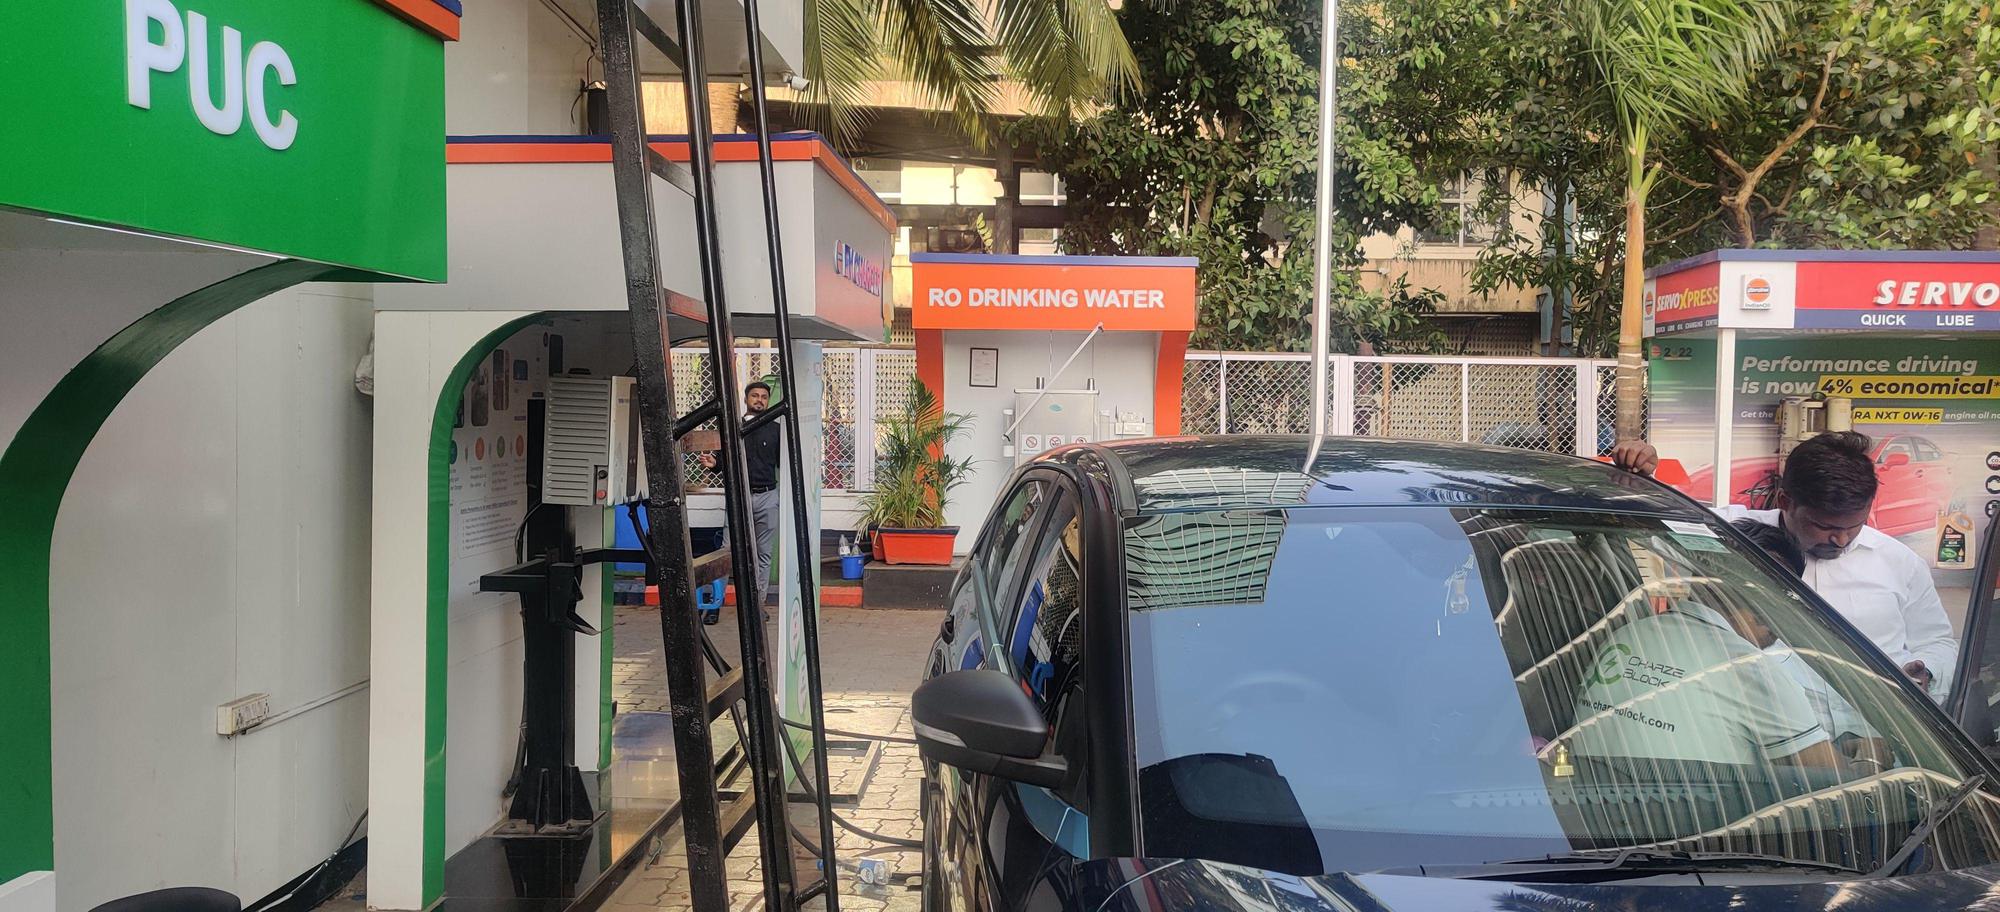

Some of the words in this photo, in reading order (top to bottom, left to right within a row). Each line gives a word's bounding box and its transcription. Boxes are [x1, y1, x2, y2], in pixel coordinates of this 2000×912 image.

[124, 0, 299, 151] PUC
[928, 287, 962, 308] RO
[968, 287, 1079, 308] DRINKING
[1084, 289, 1165, 309] WATER
[1874, 279, 2000, 307] SERVO
[1860, 314, 1906, 327] QUICK
[1936, 315, 1975, 326] LUBE
[1742, 356, 1890, 372] Performance
[1896, 355, 1978, 376] driving
[1741, 376, 1760, 394] is
[1765, 381, 1816, 394] now
[1820, 378, 1853, 394] 4%
[1741, 410, 1757, 418] Get
[1758, 410, 1774, 418] the
[1854, 411, 1871, 420] RA
[1874, 411, 1900, 420] NXT
[1903, 411, 1941, 420] 0W-16
[1944, 410, 1976, 421] engine
[1978, 411, 1990, 419] oil
[1622, 668, 1670, 688] BLOCK
[1628, 656, 1686, 679] CHARZE
